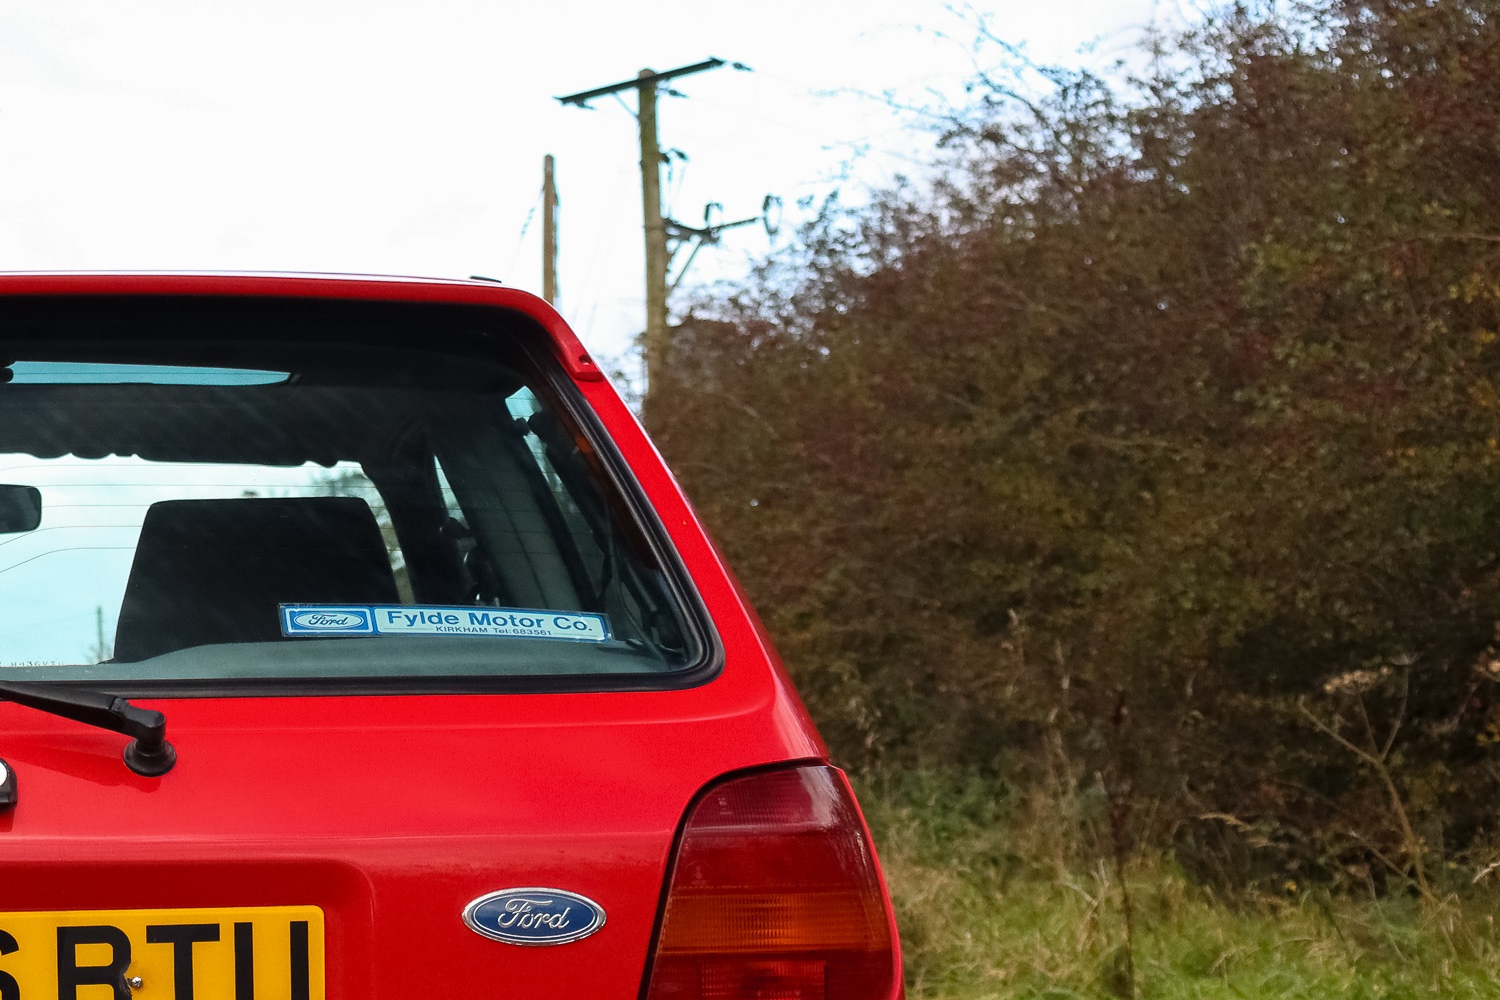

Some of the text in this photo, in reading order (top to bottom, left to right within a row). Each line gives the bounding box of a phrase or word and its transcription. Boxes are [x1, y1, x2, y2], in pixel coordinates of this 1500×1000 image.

[308, 614, 348, 626] Ford
[387, 610, 593, 631] Fylde Motor Co.
[435, 626, 488, 634] KIRKHAM
[498, 898, 572, 930] Ford
